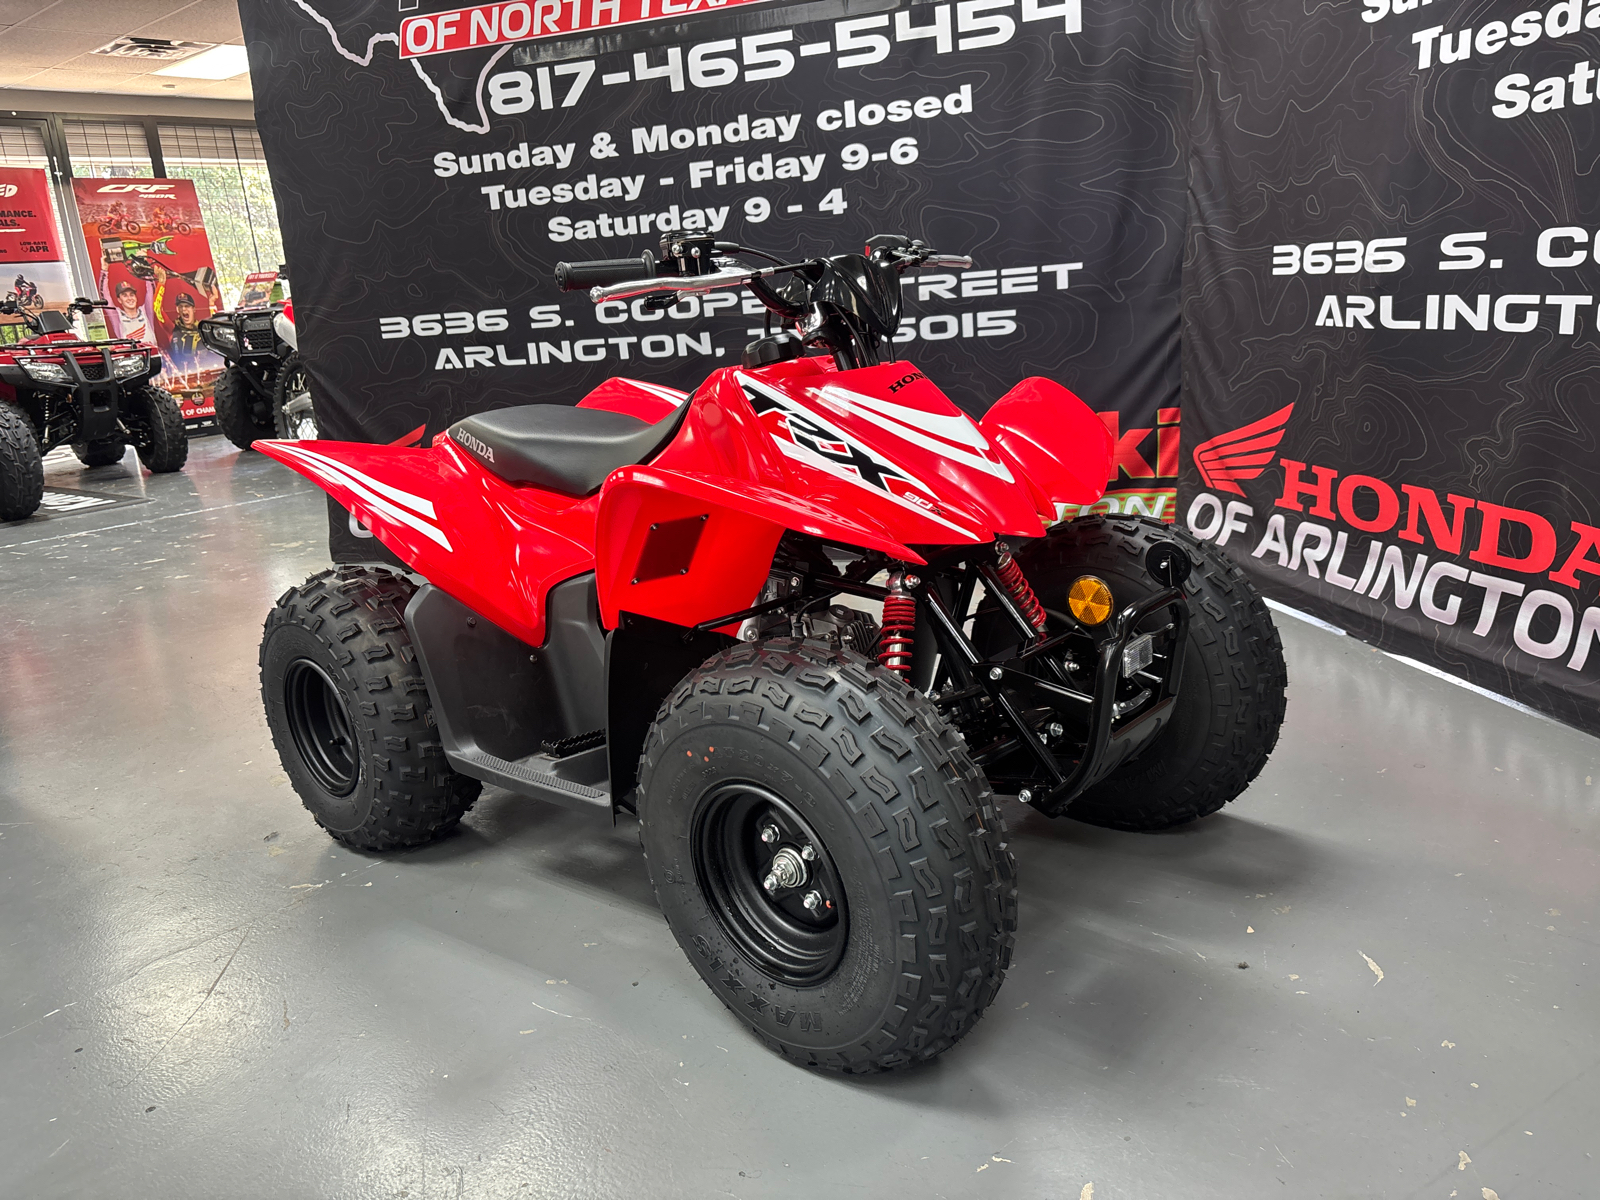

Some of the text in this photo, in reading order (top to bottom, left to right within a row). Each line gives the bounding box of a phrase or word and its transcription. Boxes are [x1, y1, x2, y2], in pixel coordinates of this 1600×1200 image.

[406, 13, 461, 54] OF
[469, 0, 622, 45] NORTH
[487, 0, 1083, 115] 817-465-5454
[1491, 61, 1600, 118] Sat
[433, 84, 973, 178] Sunday & Monday closed
[97, 184, 175, 193] CRF
[481, 136, 919, 210] Tuesday - Friday 9-6
[548, 188, 848, 242] Saturday 9 - 4
[29, 245, 49, 253] APR
[1272, 237, 1407, 276] 3636
[1438, 231, 1503, 271] S.
[379, 308, 509, 340] 3636
[529, 304, 575, 329] S.
[594, 290, 767, 325] COOPE
[1315, 294, 1600, 335] ARLINGT
[434, 332, 725, 371] ARLINGTON,
[887, 372, 928, 394] HON
[456, 427, 495, 464] HONDA
[1186, 492, 1254, 547] OF
[1274, 457, 1600, 597] HONDA
